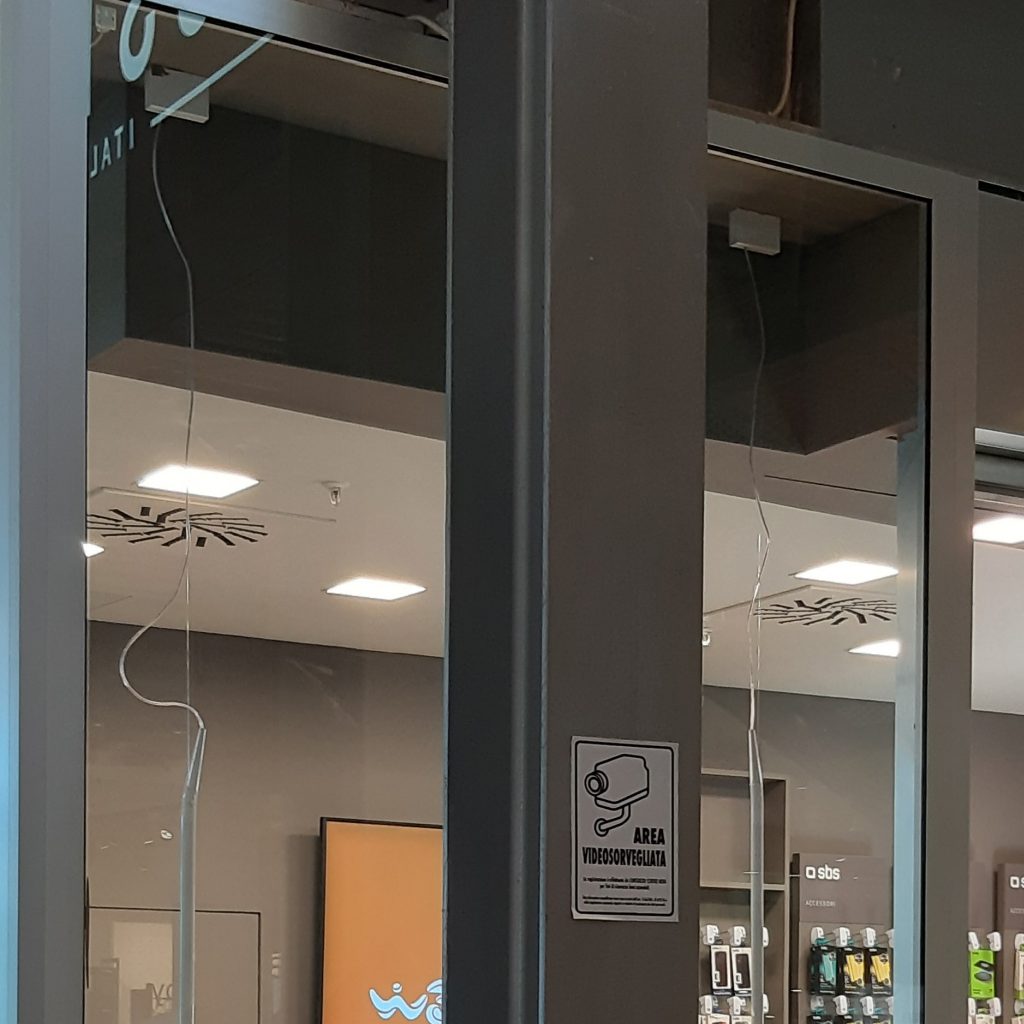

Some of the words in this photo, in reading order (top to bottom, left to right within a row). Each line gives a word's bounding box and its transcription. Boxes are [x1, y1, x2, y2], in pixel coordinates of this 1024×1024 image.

[633, 827, 665, 845] AREA
[582, 847, 666, 867] VIDEOSORVEGLIATA
[817, 864, 840, 880] sbs
